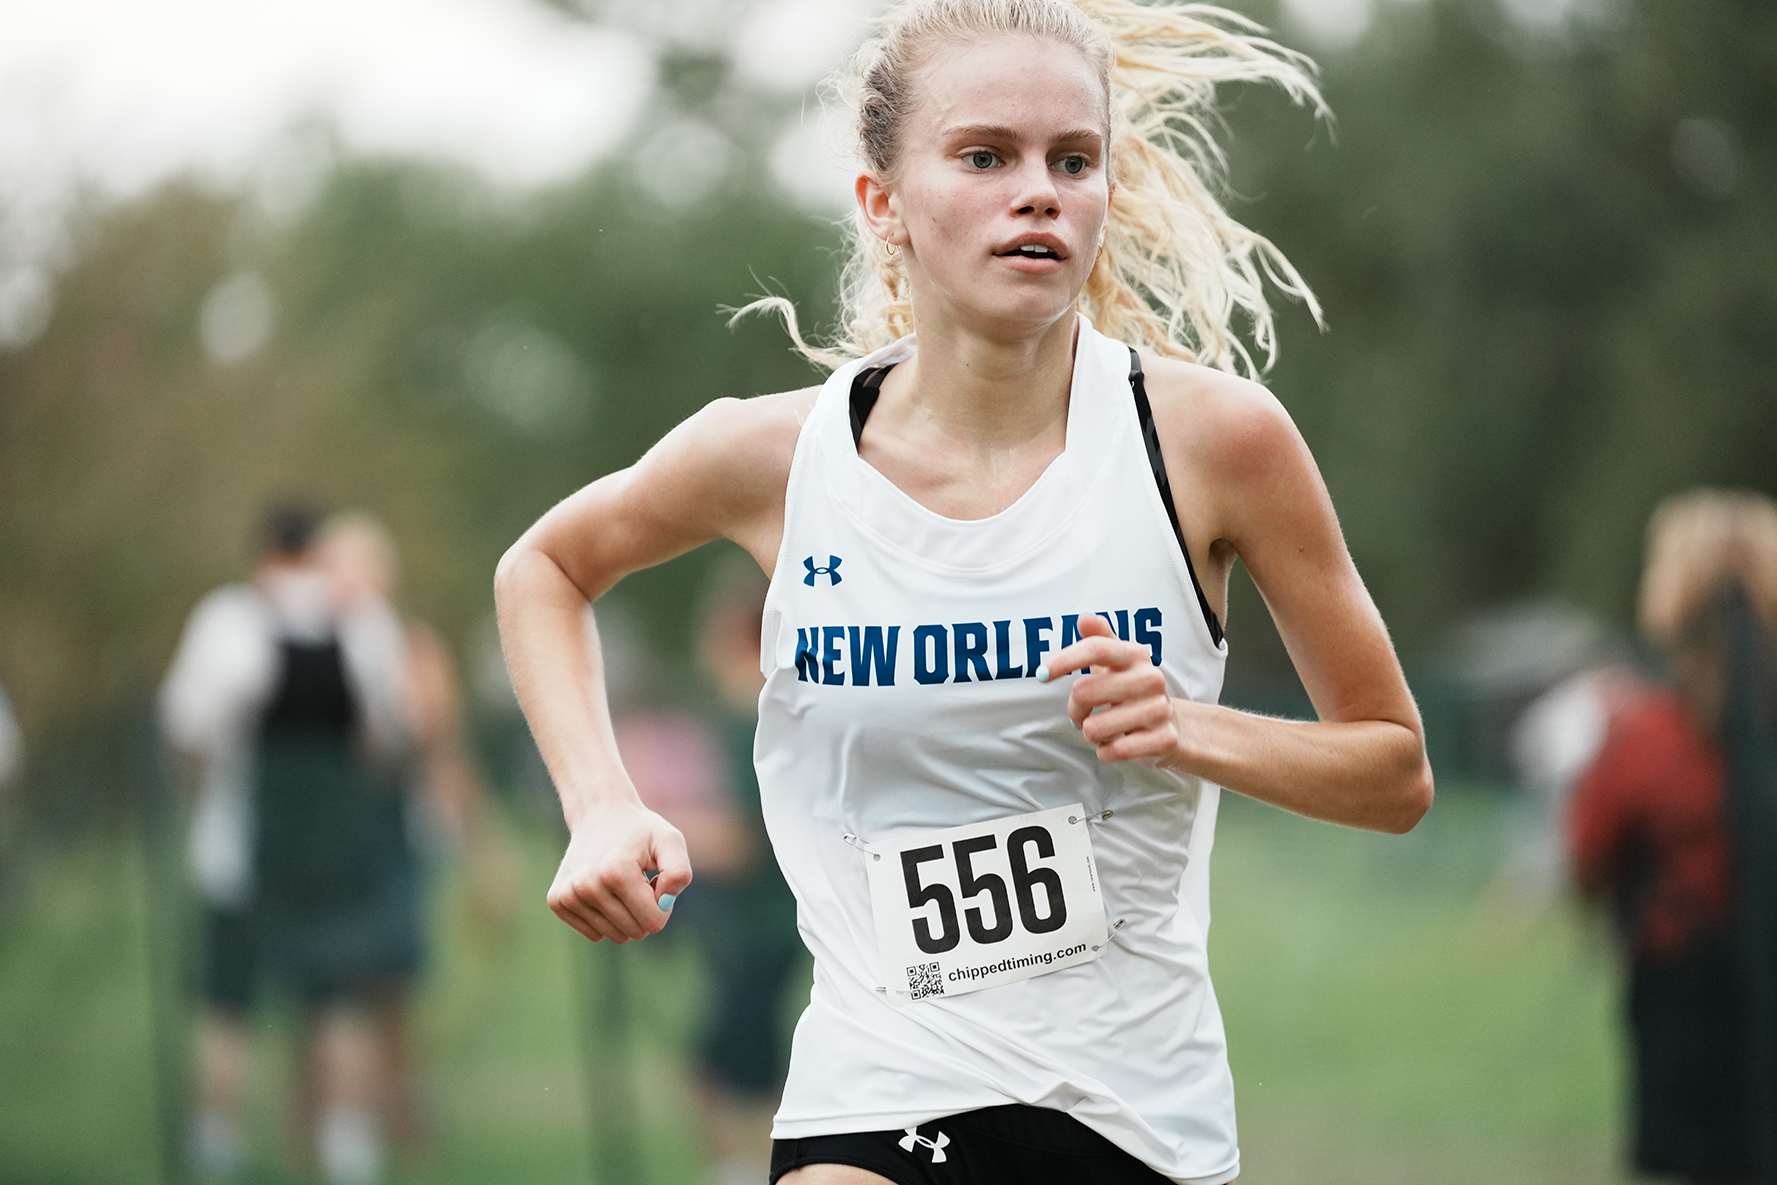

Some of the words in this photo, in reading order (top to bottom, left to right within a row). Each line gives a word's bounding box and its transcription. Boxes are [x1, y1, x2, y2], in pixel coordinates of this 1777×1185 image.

[795, 626, 900, 687] NEW
[900, 825, 1067, 955] 556
[947, 943, 1087, 983] chippedtiming.com
